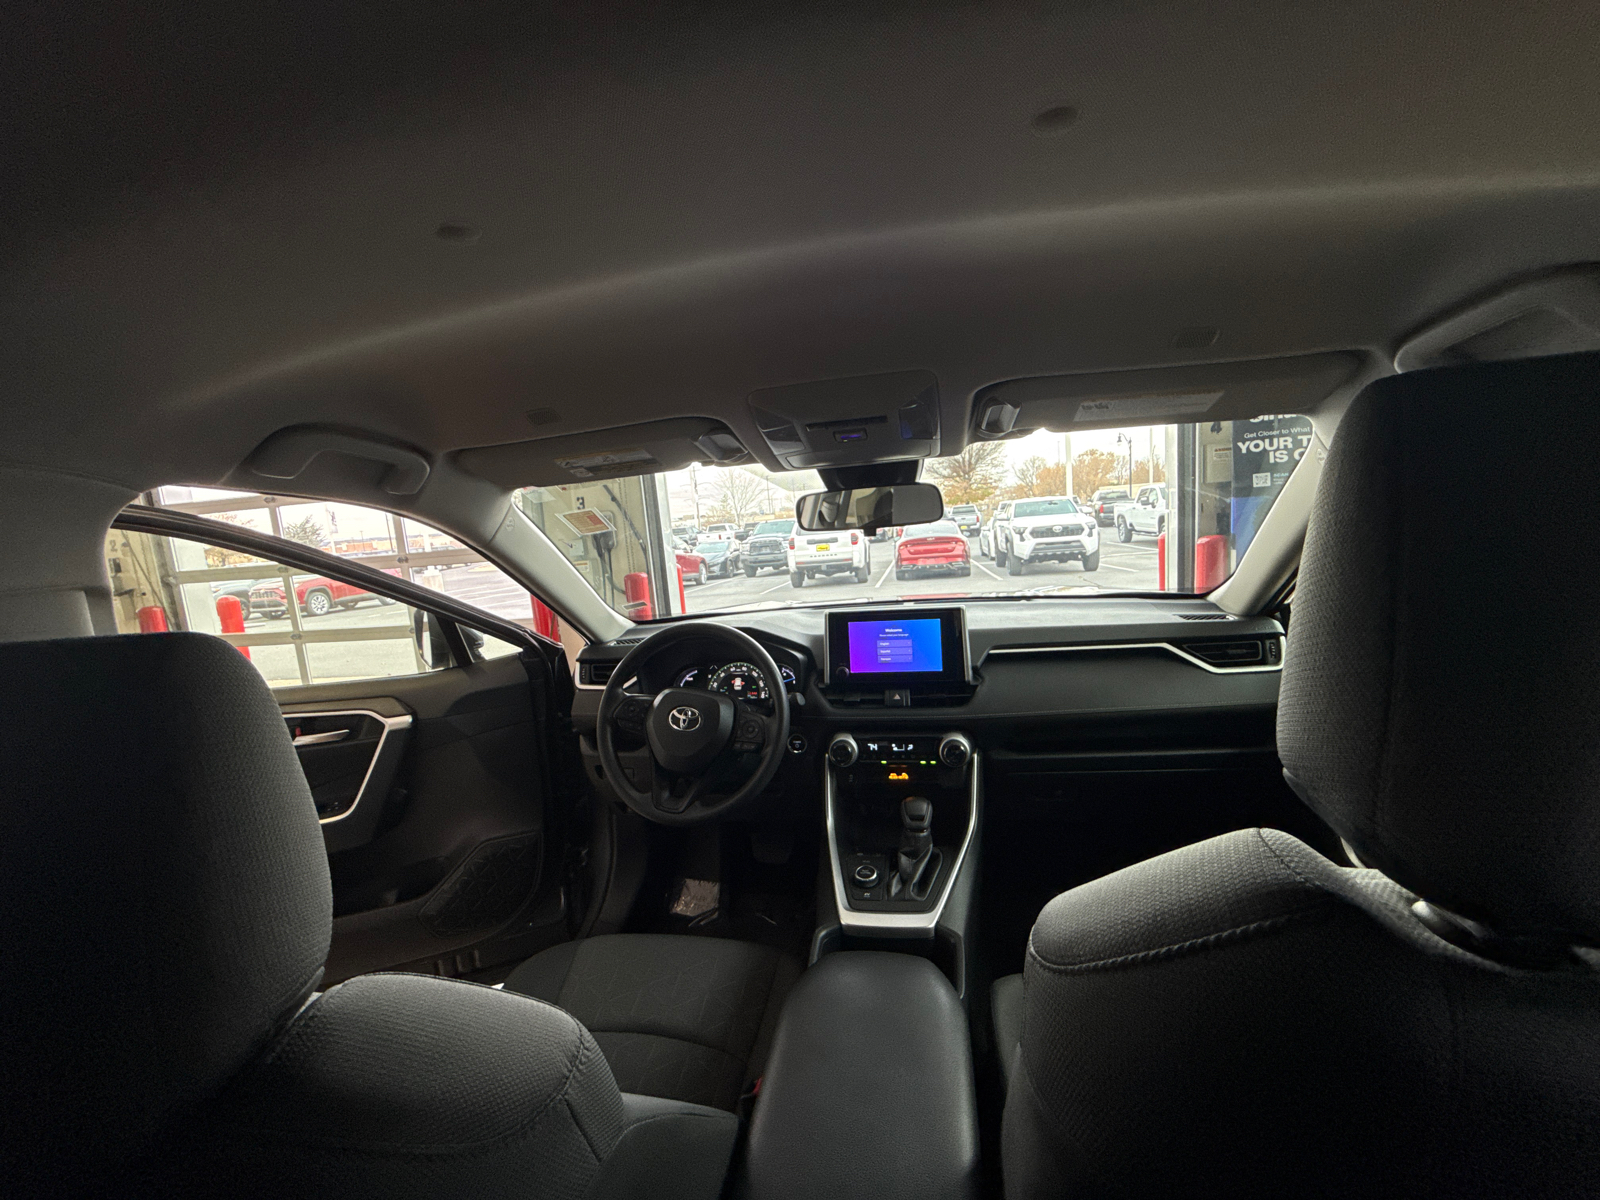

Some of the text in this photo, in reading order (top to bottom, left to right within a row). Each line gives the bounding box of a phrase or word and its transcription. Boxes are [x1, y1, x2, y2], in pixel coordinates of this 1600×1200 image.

[1257, 429, 1280, 437] Closer
[1290, 426, 1310, 434] What
[1237, 437, 1293, 454] YOUR
[1269, 451, 1289, 463] IS
[576, 496, 585, 510] 3
[109, 539, 118, 553] 2
[867, 743, 878, 751] 74
